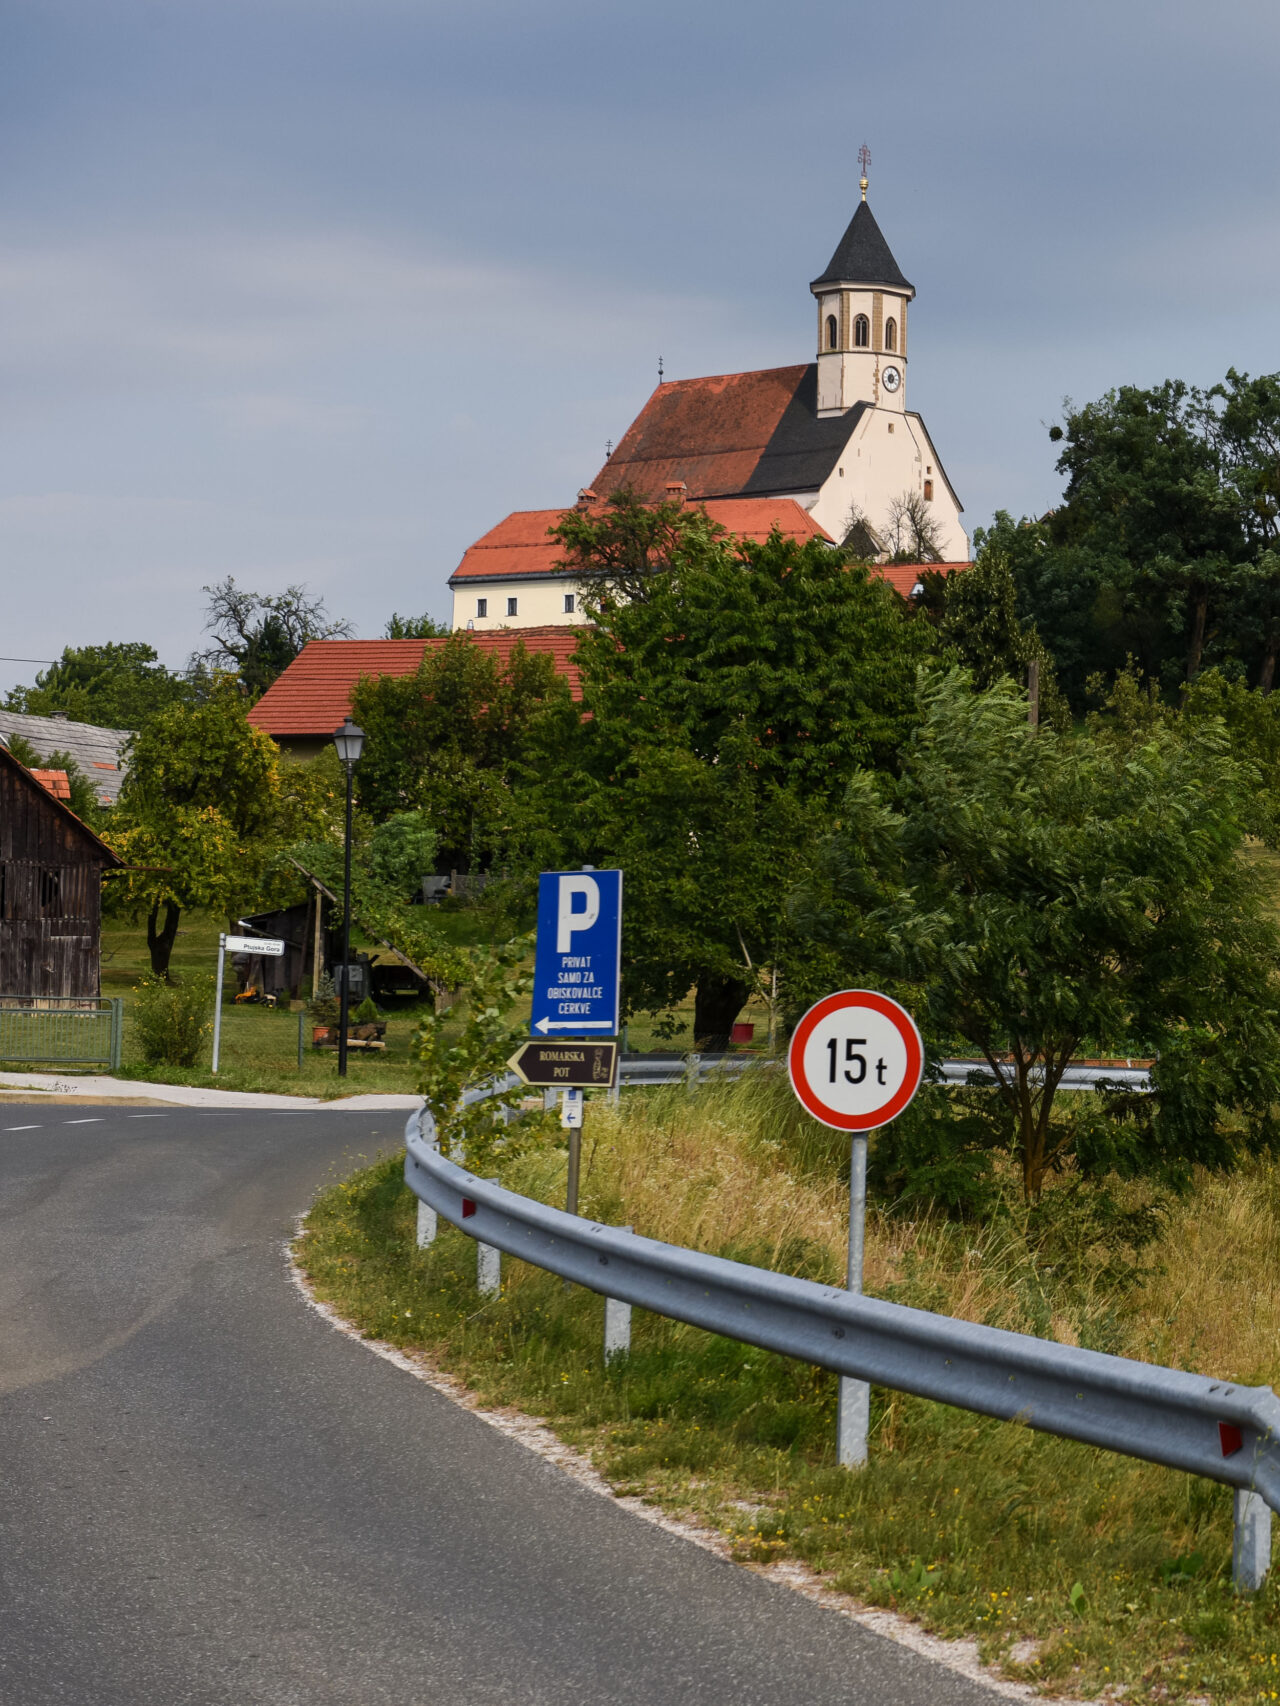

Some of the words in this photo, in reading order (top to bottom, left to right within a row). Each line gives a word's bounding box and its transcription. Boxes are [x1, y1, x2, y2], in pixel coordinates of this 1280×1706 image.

[556, 874, 600, 953] P
[243, 943, 265, 951] Ptujska
[561, 956, 592, 968] PRIVAT
[557, 972, 582, 984] SAMO
[583, 972, 594, 983] ZA
[547, 987, 603, 999] OBISKOVALCE
[558, 1003, 591, 1015] CERKVE
[540, 1050, 585, 1062] ROMARSKA
[826, 1037, 867, 1085] 15
[875, 1057, 888, 1086] t
[553, 1066, 571, 1078] POT
